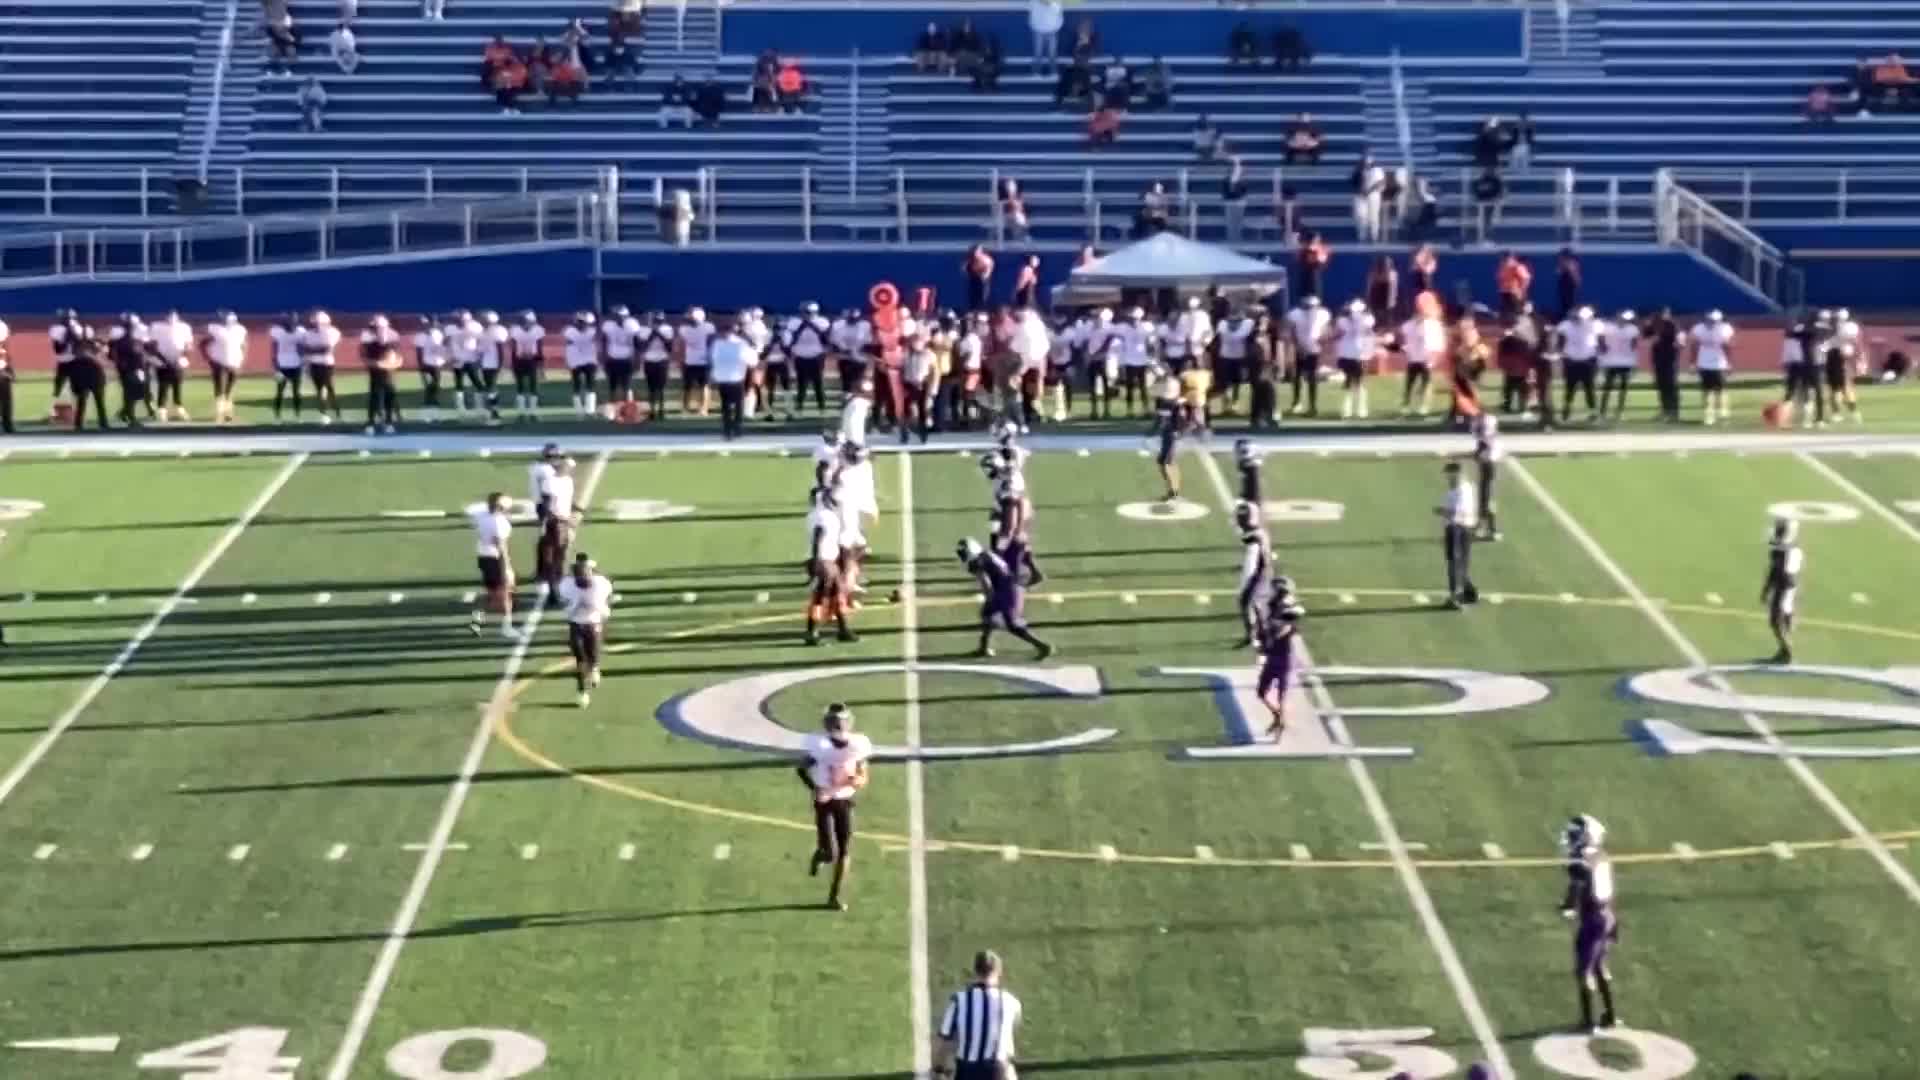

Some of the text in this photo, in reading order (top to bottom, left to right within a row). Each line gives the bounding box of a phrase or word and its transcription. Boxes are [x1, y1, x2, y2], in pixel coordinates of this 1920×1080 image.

[672, 664, 1920, 756] CPS
[137, 1027, 547, 1080] 40
[1296, 1027, 1697, 1080] 50
